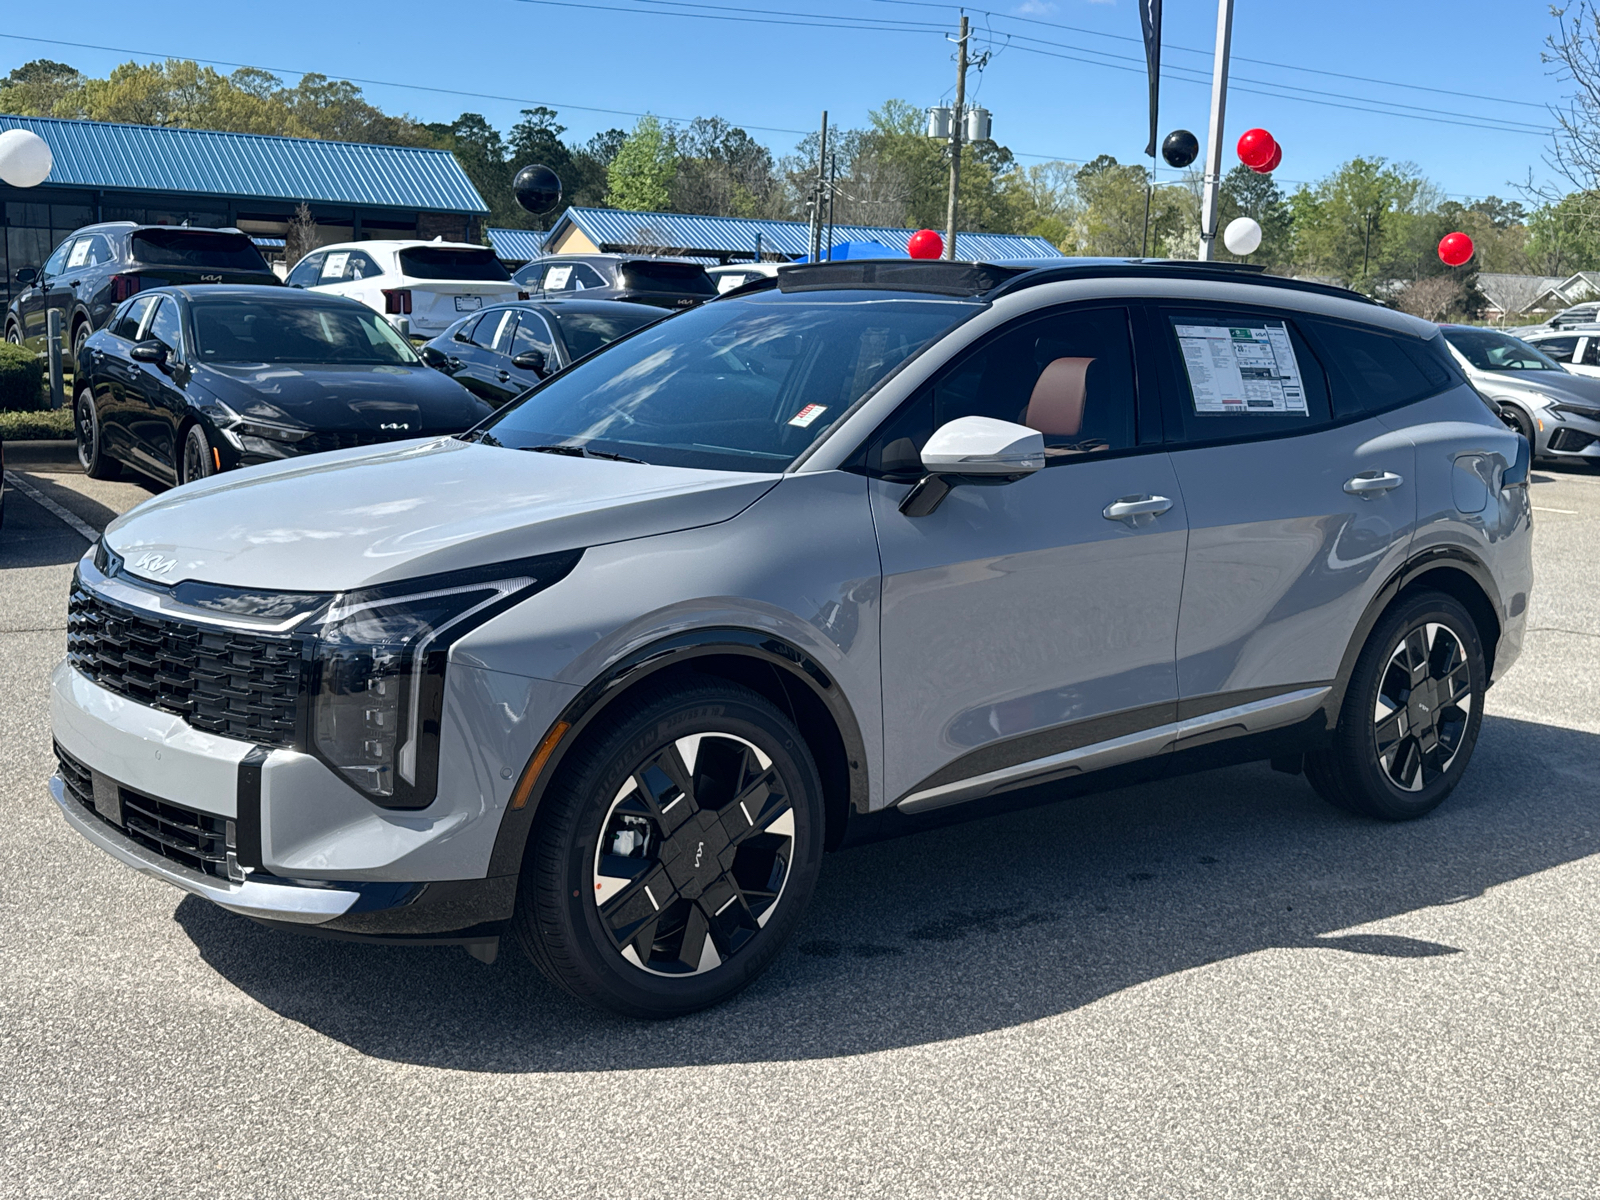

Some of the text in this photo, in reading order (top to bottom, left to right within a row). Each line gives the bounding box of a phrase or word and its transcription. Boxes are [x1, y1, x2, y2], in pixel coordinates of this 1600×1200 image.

[135, 552, 178, 575] KIA
[594, 730, 656, 807] MICHELIN
[694, 841, 704, 868] KIA
